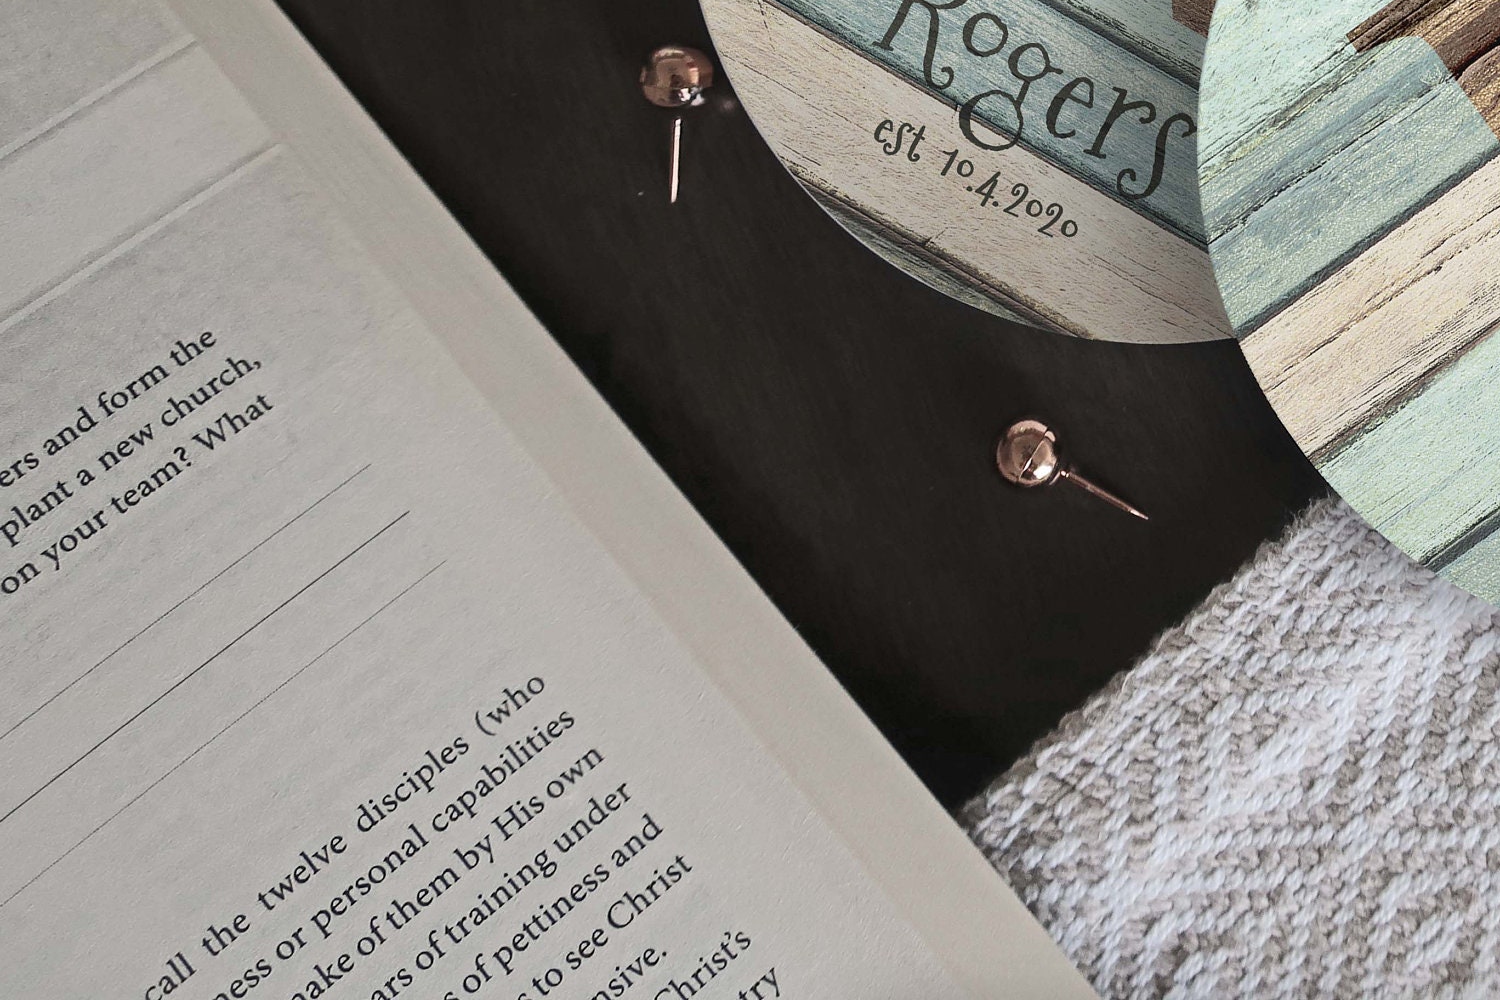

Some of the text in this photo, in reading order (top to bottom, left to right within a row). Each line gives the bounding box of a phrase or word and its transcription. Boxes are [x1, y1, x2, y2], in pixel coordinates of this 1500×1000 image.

[873, 119, 1078, 238] est 10.4.2020
[0, 329, 217, 487] ers and form the
[0, 357, 262, 548] plant a new church,
[1, 394, 274, 594] on your team? What
[145, 674, 546, 1000] call the twelve disciples (who
[276, 927, 308, 960] or
[310, 823, 429, 939] personal
[431, 708, 575, 833] capabilities
[357, 915, 387, 956] of
[386, 867, 461, 930] them
[453, 834, 494, 871] by
[491, 793, 546, 842] His
[545, 747, 605, 802] own
[416, 929, 447, 970] of
[444, 850, 557, 944] training
[553, 780, 633, 854] under
[463, 812, 664, 993] of pettiness and
[532, 854, 693, 996] to see Christ
